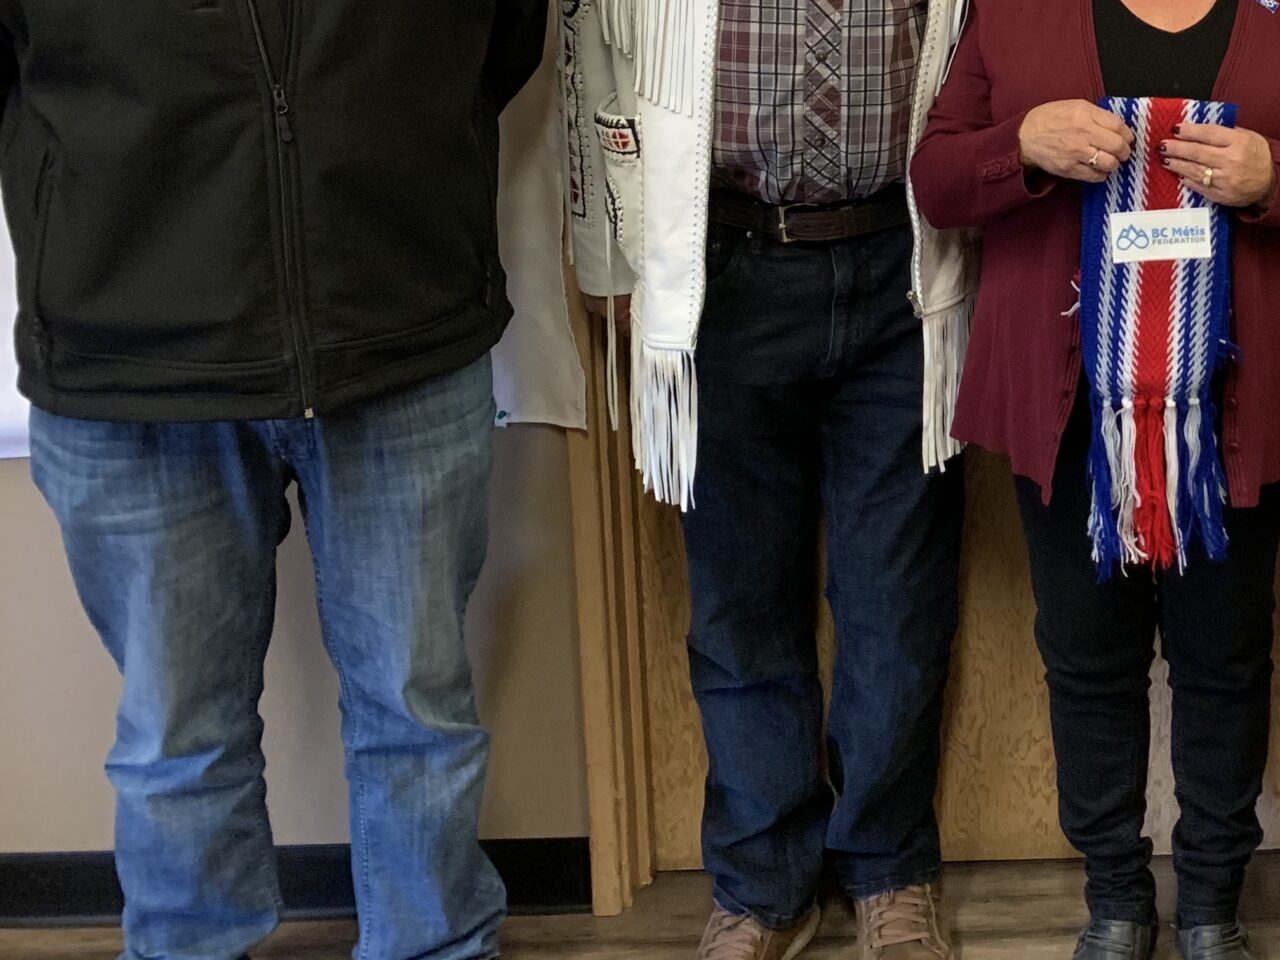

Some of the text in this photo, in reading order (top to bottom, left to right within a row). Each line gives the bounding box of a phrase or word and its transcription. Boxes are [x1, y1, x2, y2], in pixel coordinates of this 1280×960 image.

[1152, 226, 1205, 238] BC Métis
[1152, 237, 1205, 245] FEDERATION
